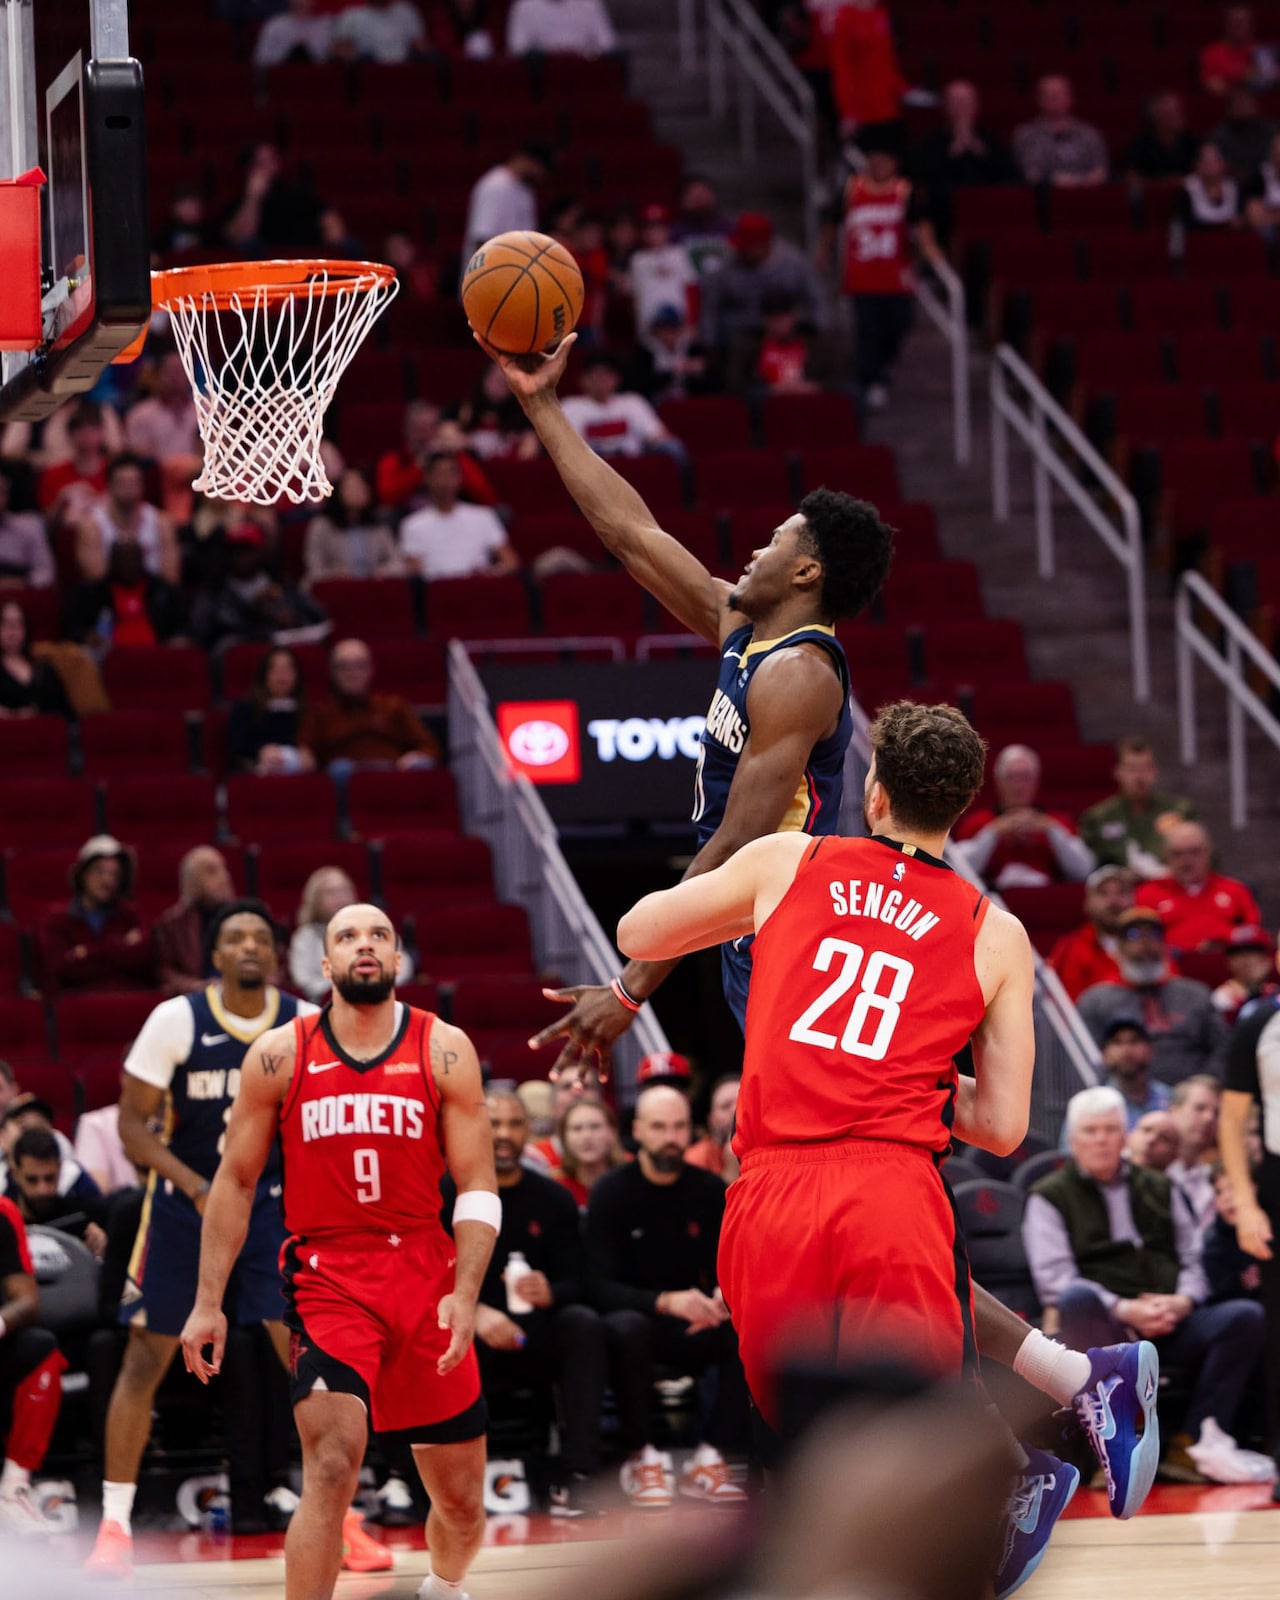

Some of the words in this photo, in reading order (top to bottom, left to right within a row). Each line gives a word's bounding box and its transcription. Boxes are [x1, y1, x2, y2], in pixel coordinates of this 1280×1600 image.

[587, 715, 707, 762] TOYO
[829, 879, 941, 941] SENGUN
[788, 937, 915, 1061] 28
[301, 1093, 425, 1143] ROCKETS
[353, 1148, 381, 1203] 9
[483, 1459, 531, 1512] G
